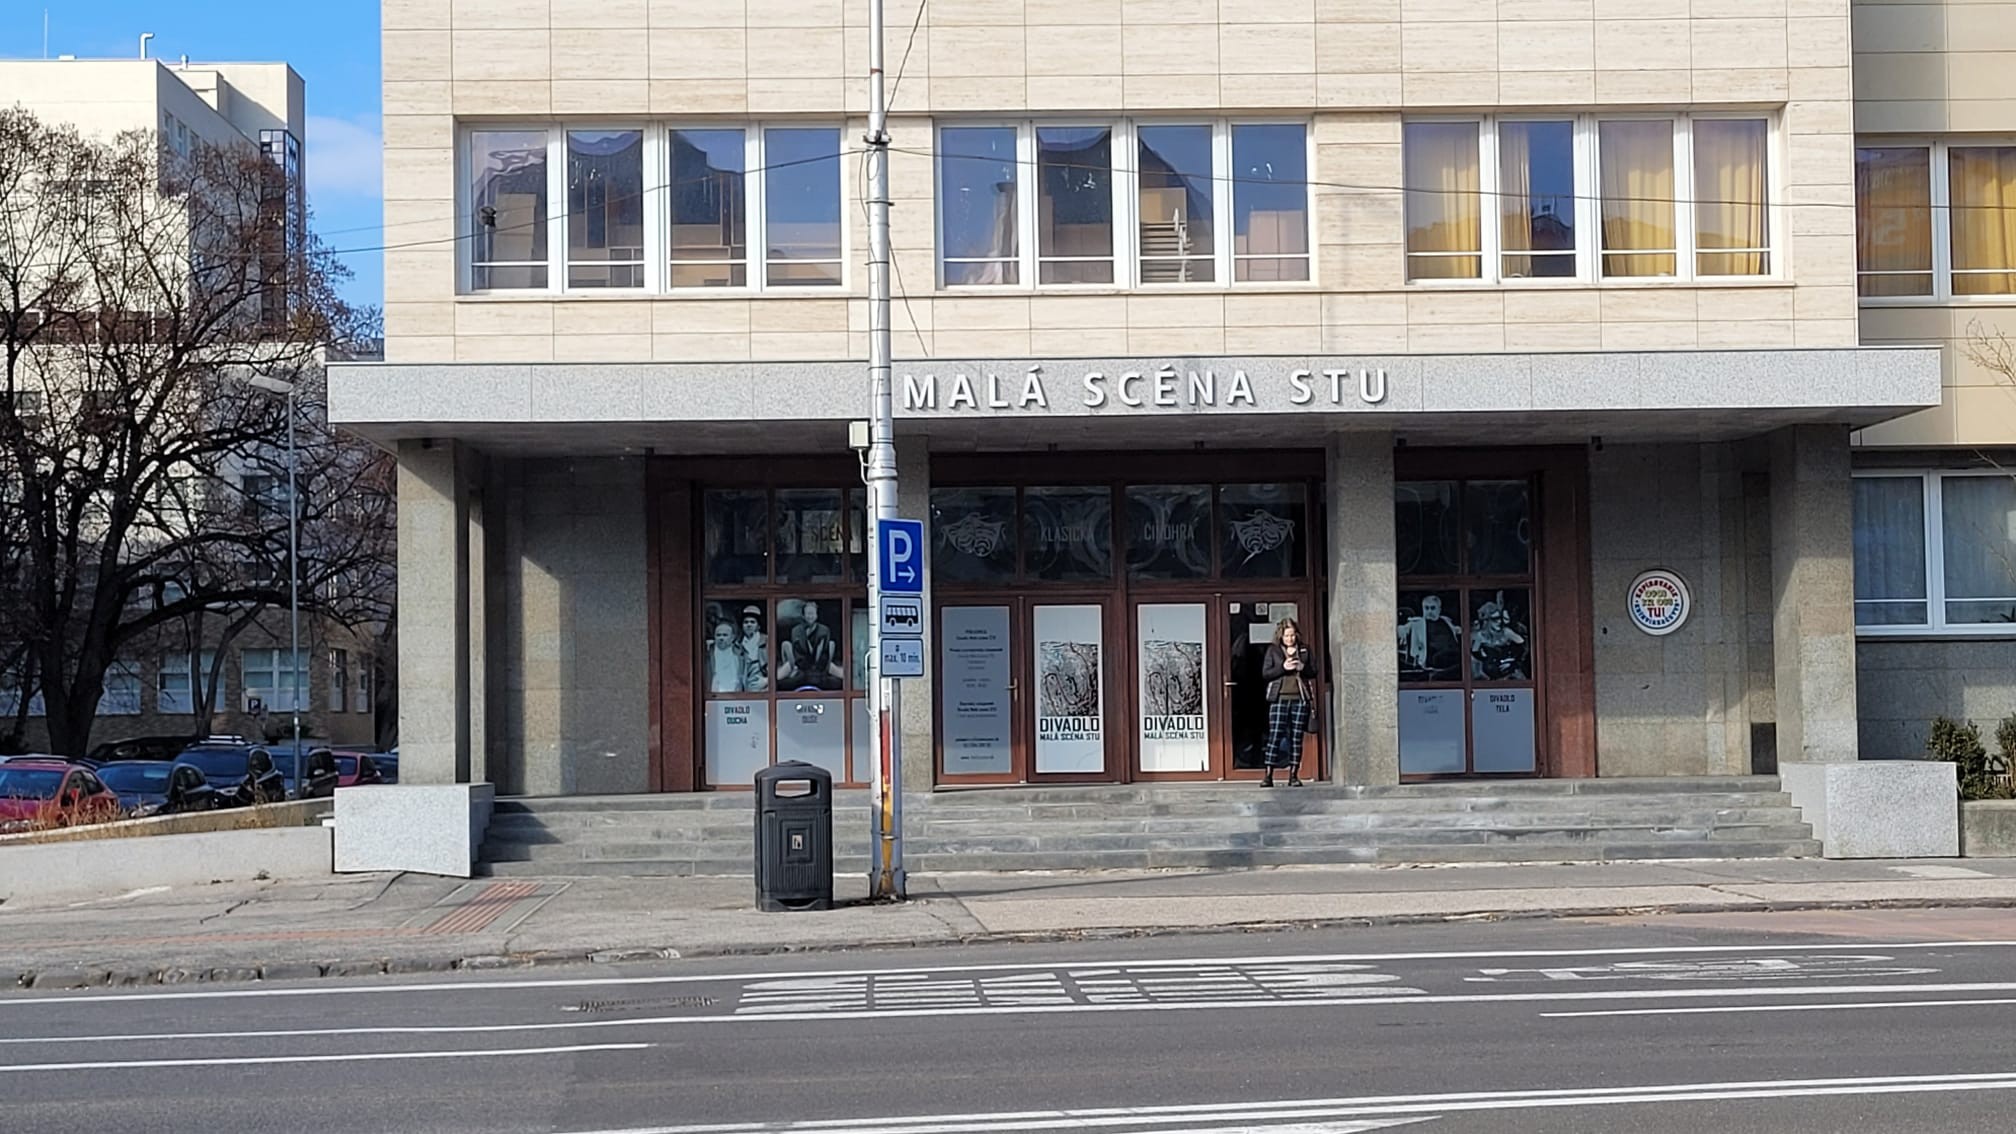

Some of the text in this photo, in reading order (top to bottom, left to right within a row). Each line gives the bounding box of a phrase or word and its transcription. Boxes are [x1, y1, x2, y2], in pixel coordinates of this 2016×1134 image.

[902, 364, 1389, 409] MALÁ SCÉNA STU
[888, 529, 913, 583] P
[1490, 694, 1515, 703] DIVADLO
[251, 699, 259, 709] P
[724, 705, 750, 714] DIVADLO
[1040, 717, 1100, 732] DIVADLO
[1144, 717, 1204, 731] DIVADLO
[1086, 732, 1100, 741] STU
[1190, 731, 1205, 739] STU
